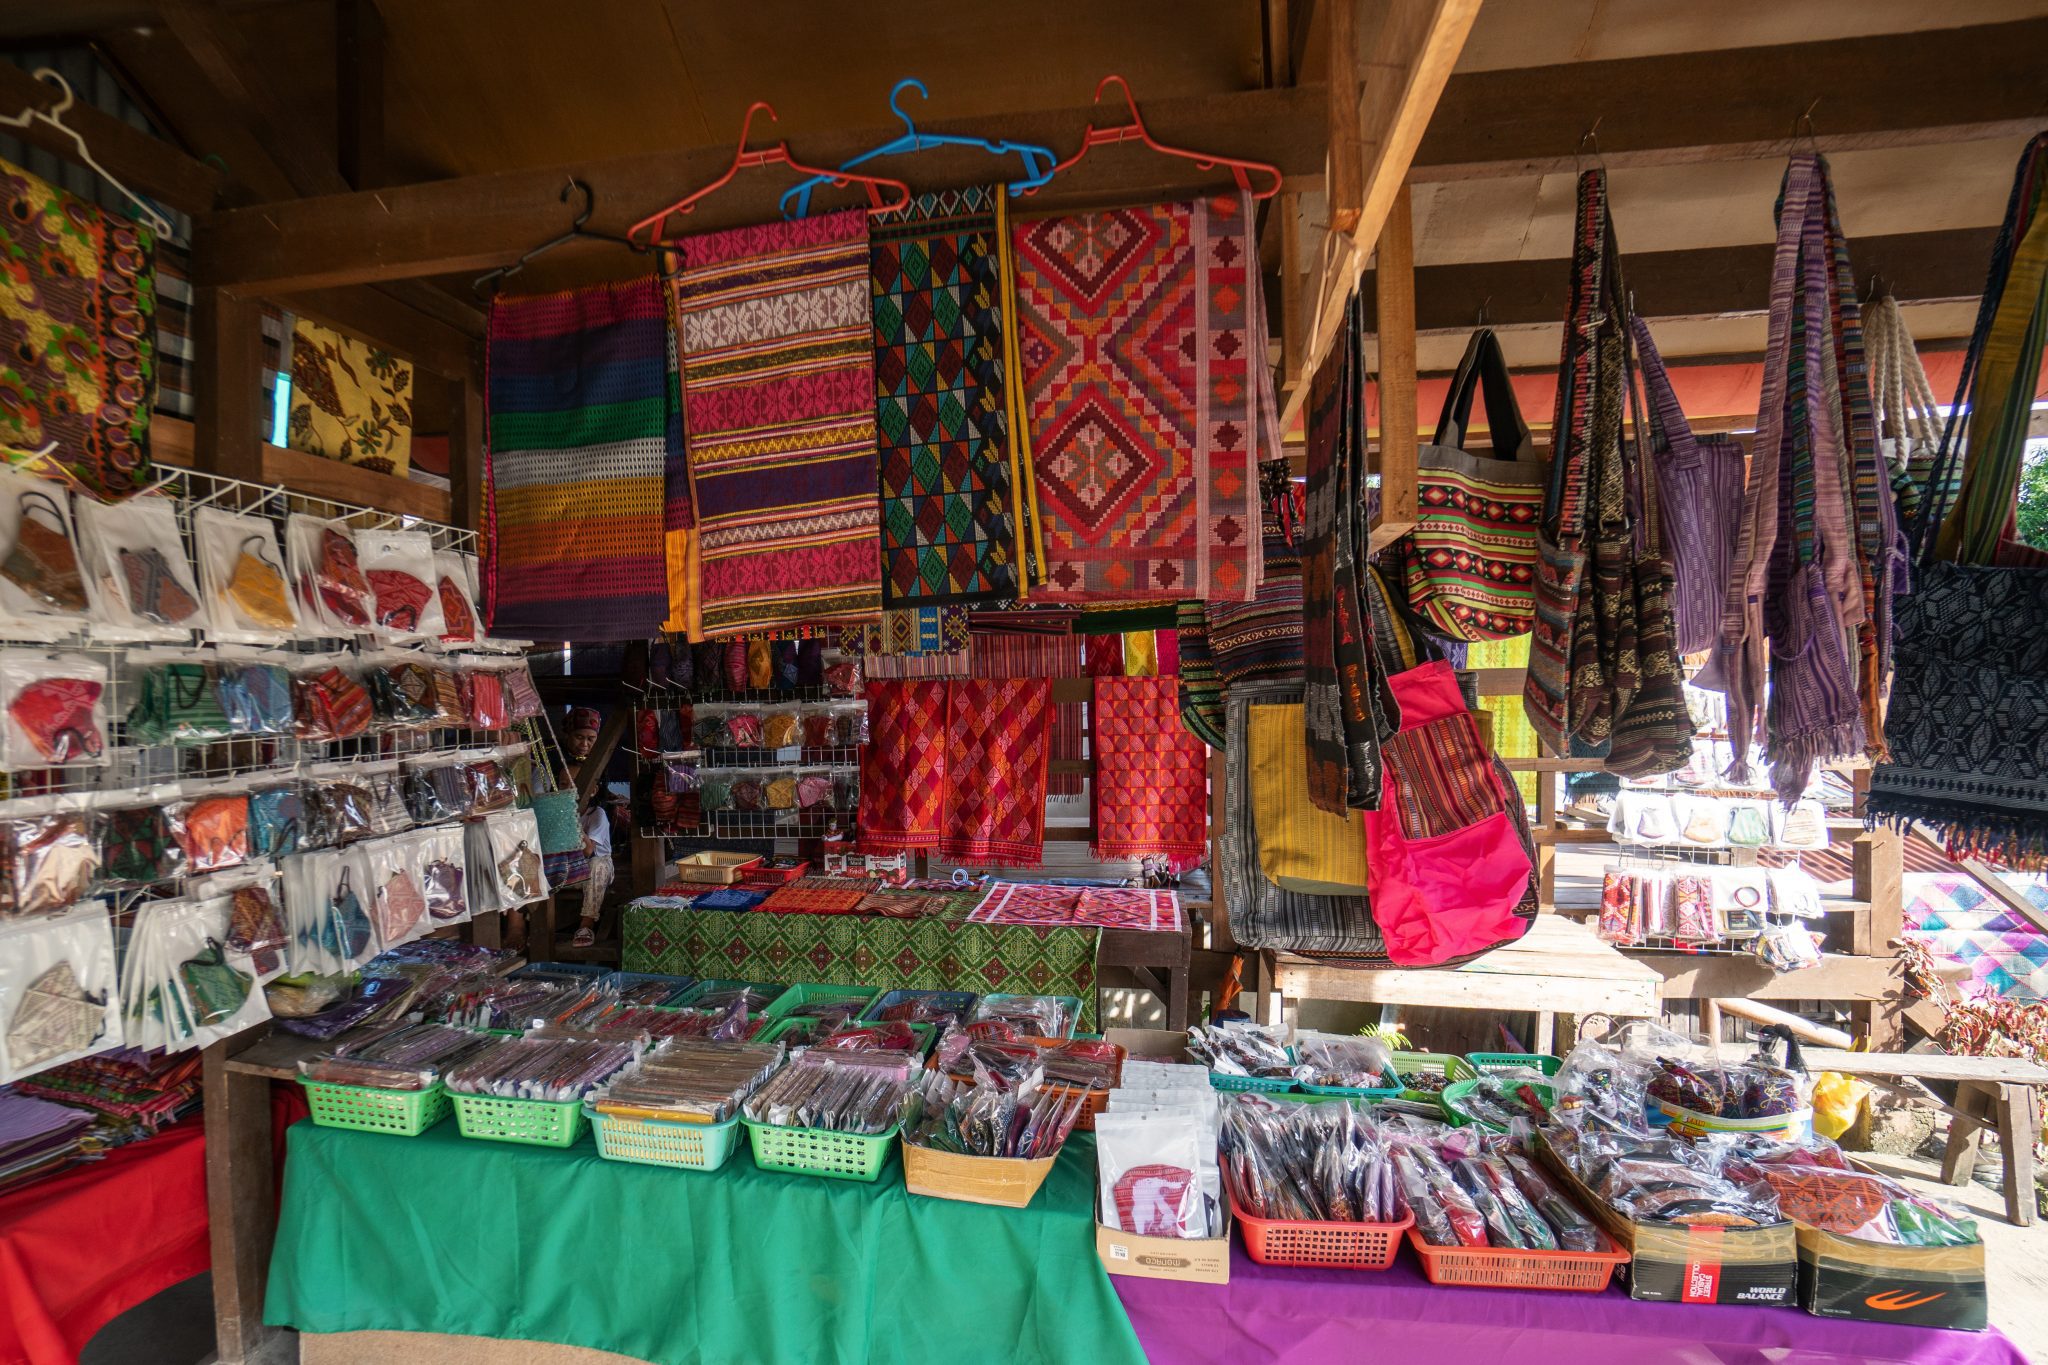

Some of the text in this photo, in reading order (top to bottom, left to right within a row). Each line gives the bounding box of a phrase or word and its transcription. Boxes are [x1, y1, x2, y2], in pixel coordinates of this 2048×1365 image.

[1689, 1260, 1700, 1297] COLLECTION
[1696, 1274, 1705, 1296] CASUAL
[1703, 1275, 1712, 1297] STREET
[1736, 1292, 1784, 1301] BALANCE
[1749, 1286, 1787, 1294] WORLD
